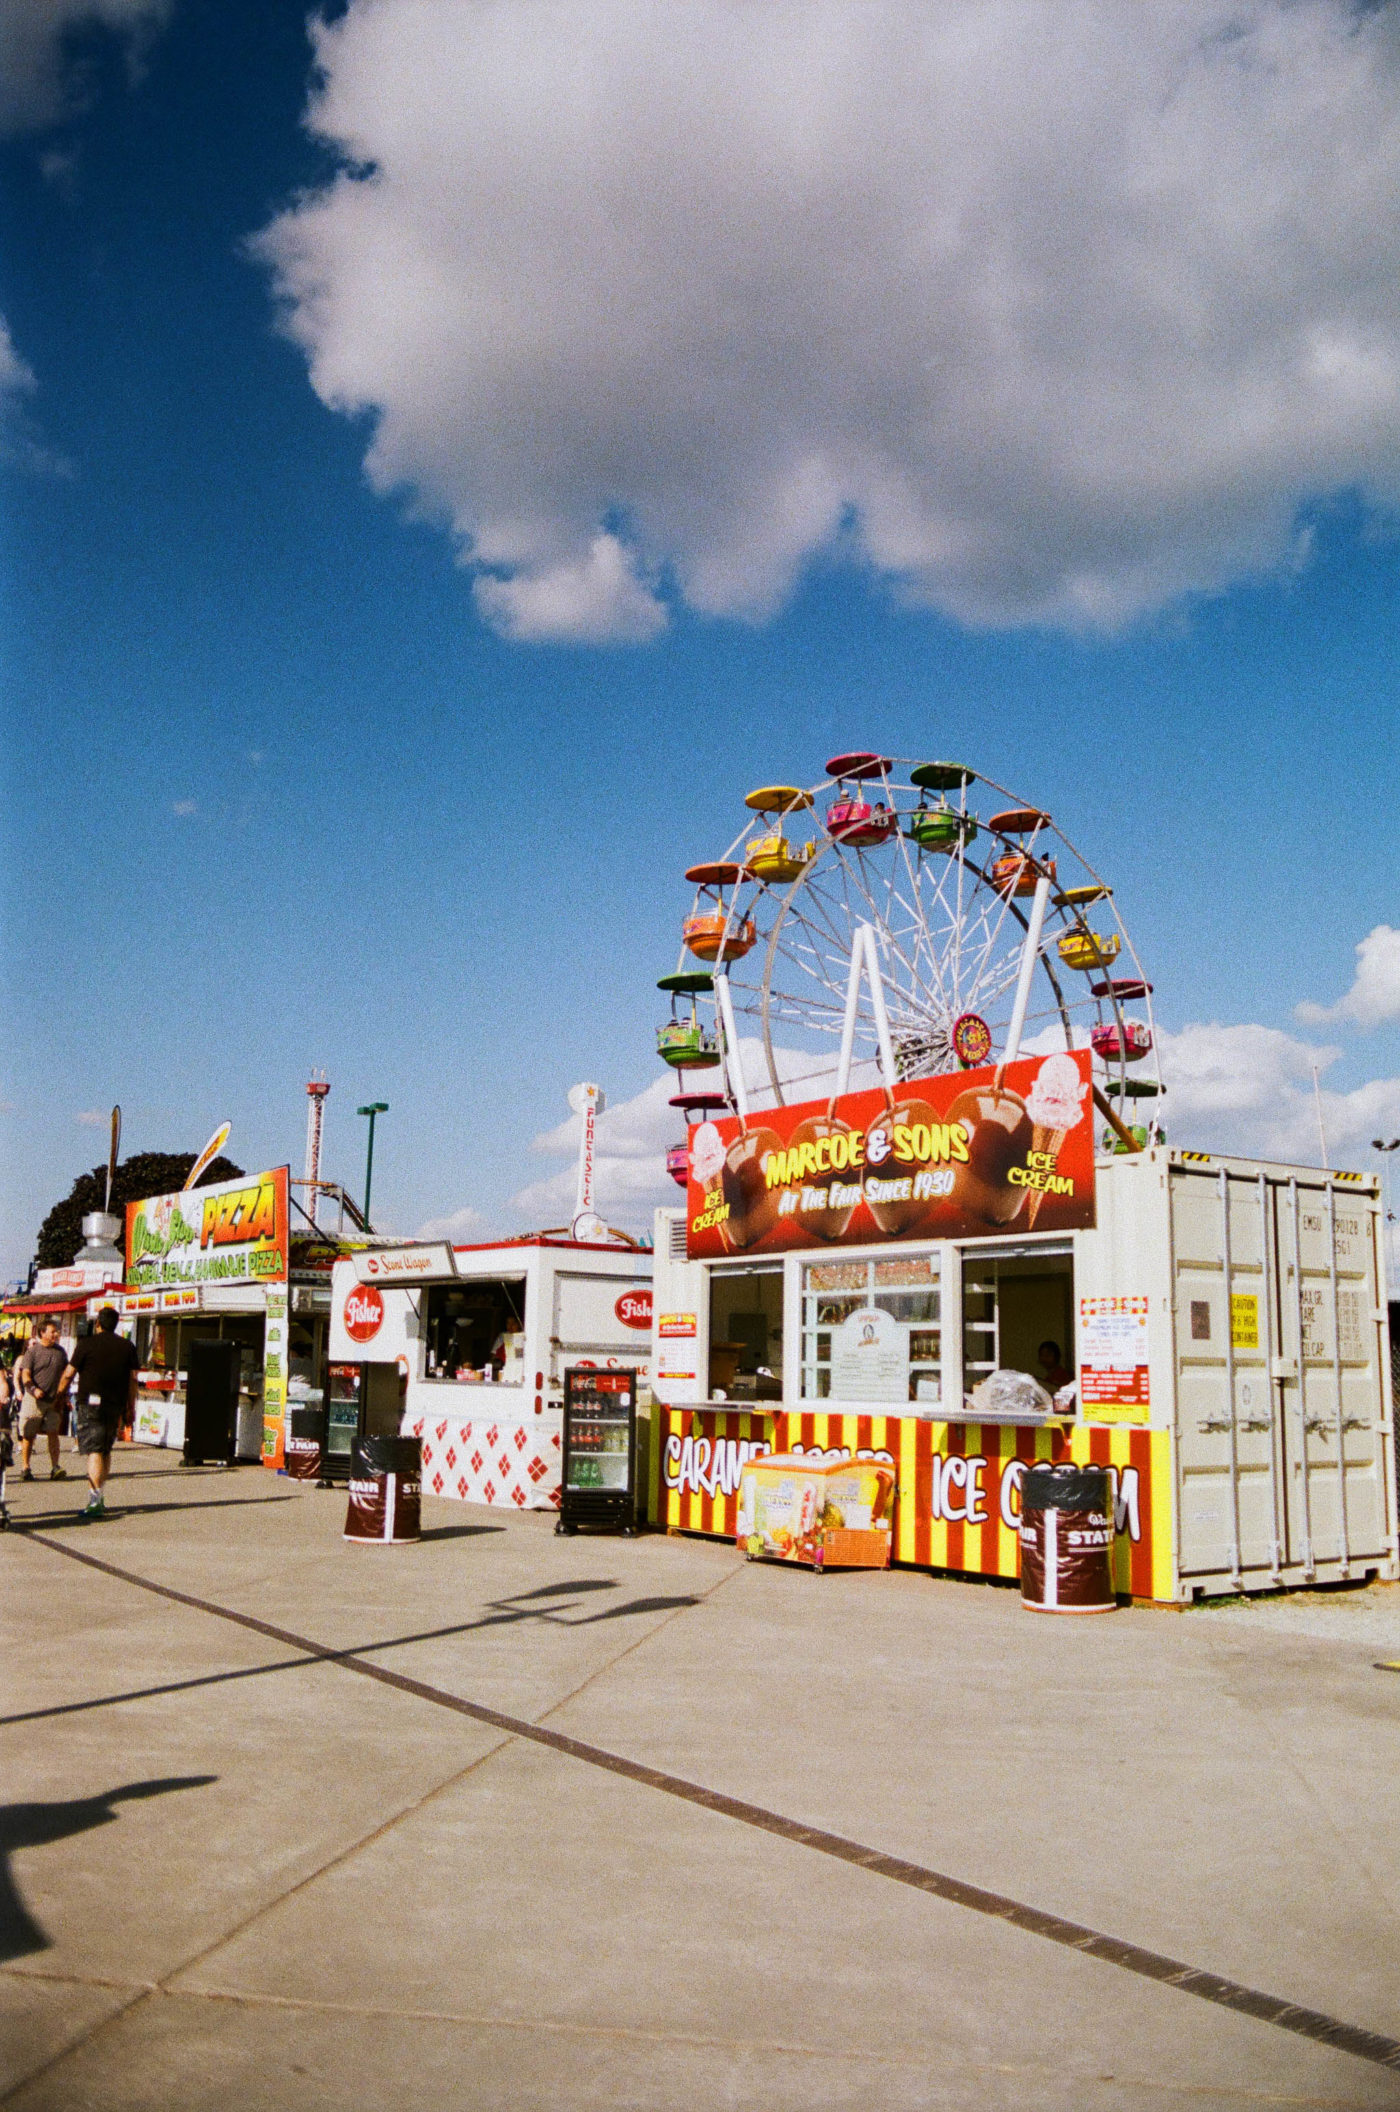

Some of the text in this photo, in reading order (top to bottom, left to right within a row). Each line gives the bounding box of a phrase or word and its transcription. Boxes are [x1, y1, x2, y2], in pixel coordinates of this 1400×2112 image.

[766, 1123, 970, 1189] MARCOE & SONS
[1026, 1150, 1057, 1171] ICE
[913, 1168, 955, 1200] 1930
[1007, 1167, 1074, 1197] CREAM
[704, 1188, 722, 1210] ICE
[200, 1182, 276, 1250] PIZZA
[692, 1203, 730, 1233] CREAM
[1333, 1218, 1358, 1235] 90128
[248, 1248, 284, 1277] PIZZA
[1334, 1240, 1351, 1255] 5G1
[380, 1254, 432, 1275] Scone Wagon
[347, 1297, 381, 1328] Fisher
[621, 1298, 652, 1319] Fish
[664, 1434, 772, 1499] CARAM
[931, 1454, 989, 1524] ICE
